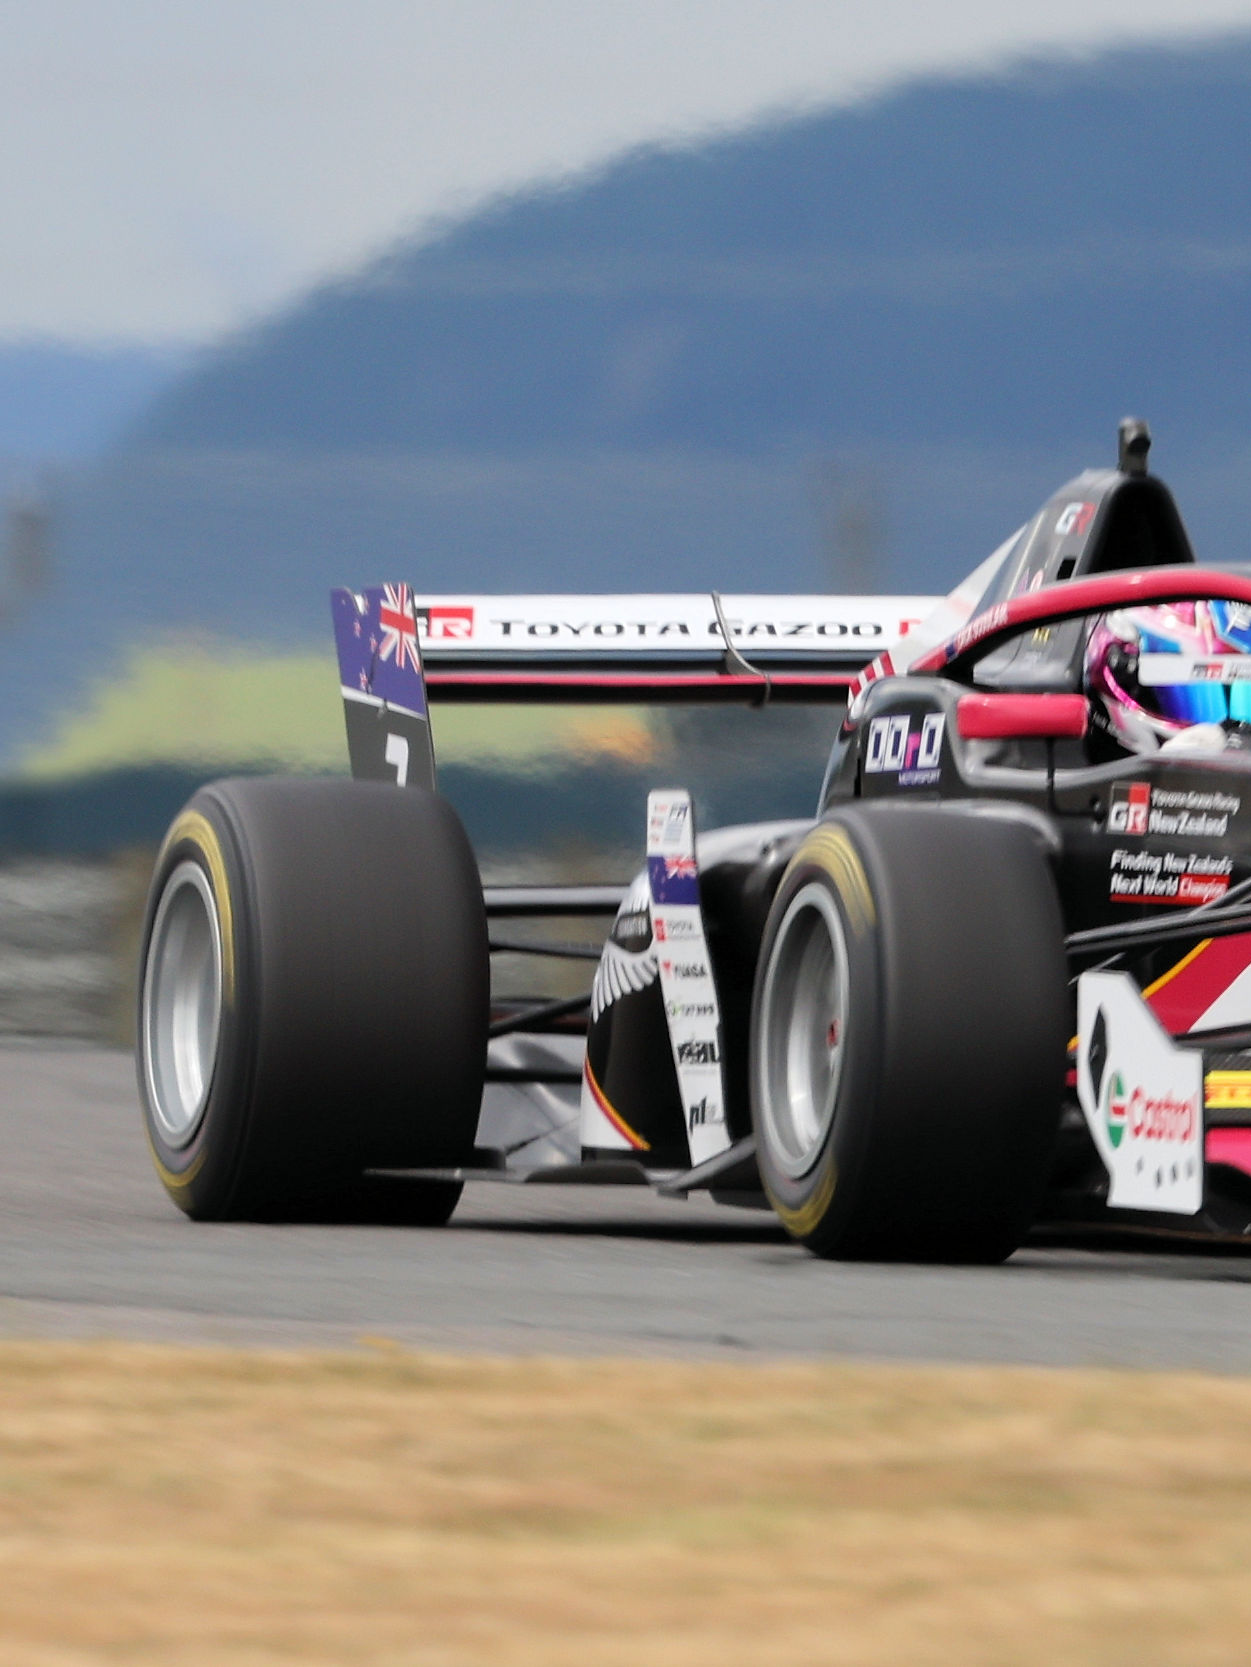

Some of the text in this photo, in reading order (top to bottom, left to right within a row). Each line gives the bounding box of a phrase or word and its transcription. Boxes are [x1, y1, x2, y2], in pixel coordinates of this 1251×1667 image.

[1055, 502, 1096, 536] GR
[489, 618, 690, 636] TOYOTA
[707, 618, 883, 637] GAZOO
[1109, 801, 1147, 833] GR
[1148, 808, 1229, 837] New Zealand
[1110, 849, 1163, 877] Finding
[1162, 852, 1189, 874] New
[1110, 873, 1143, 894] Next
[1142, 875, 1180, 896] World
